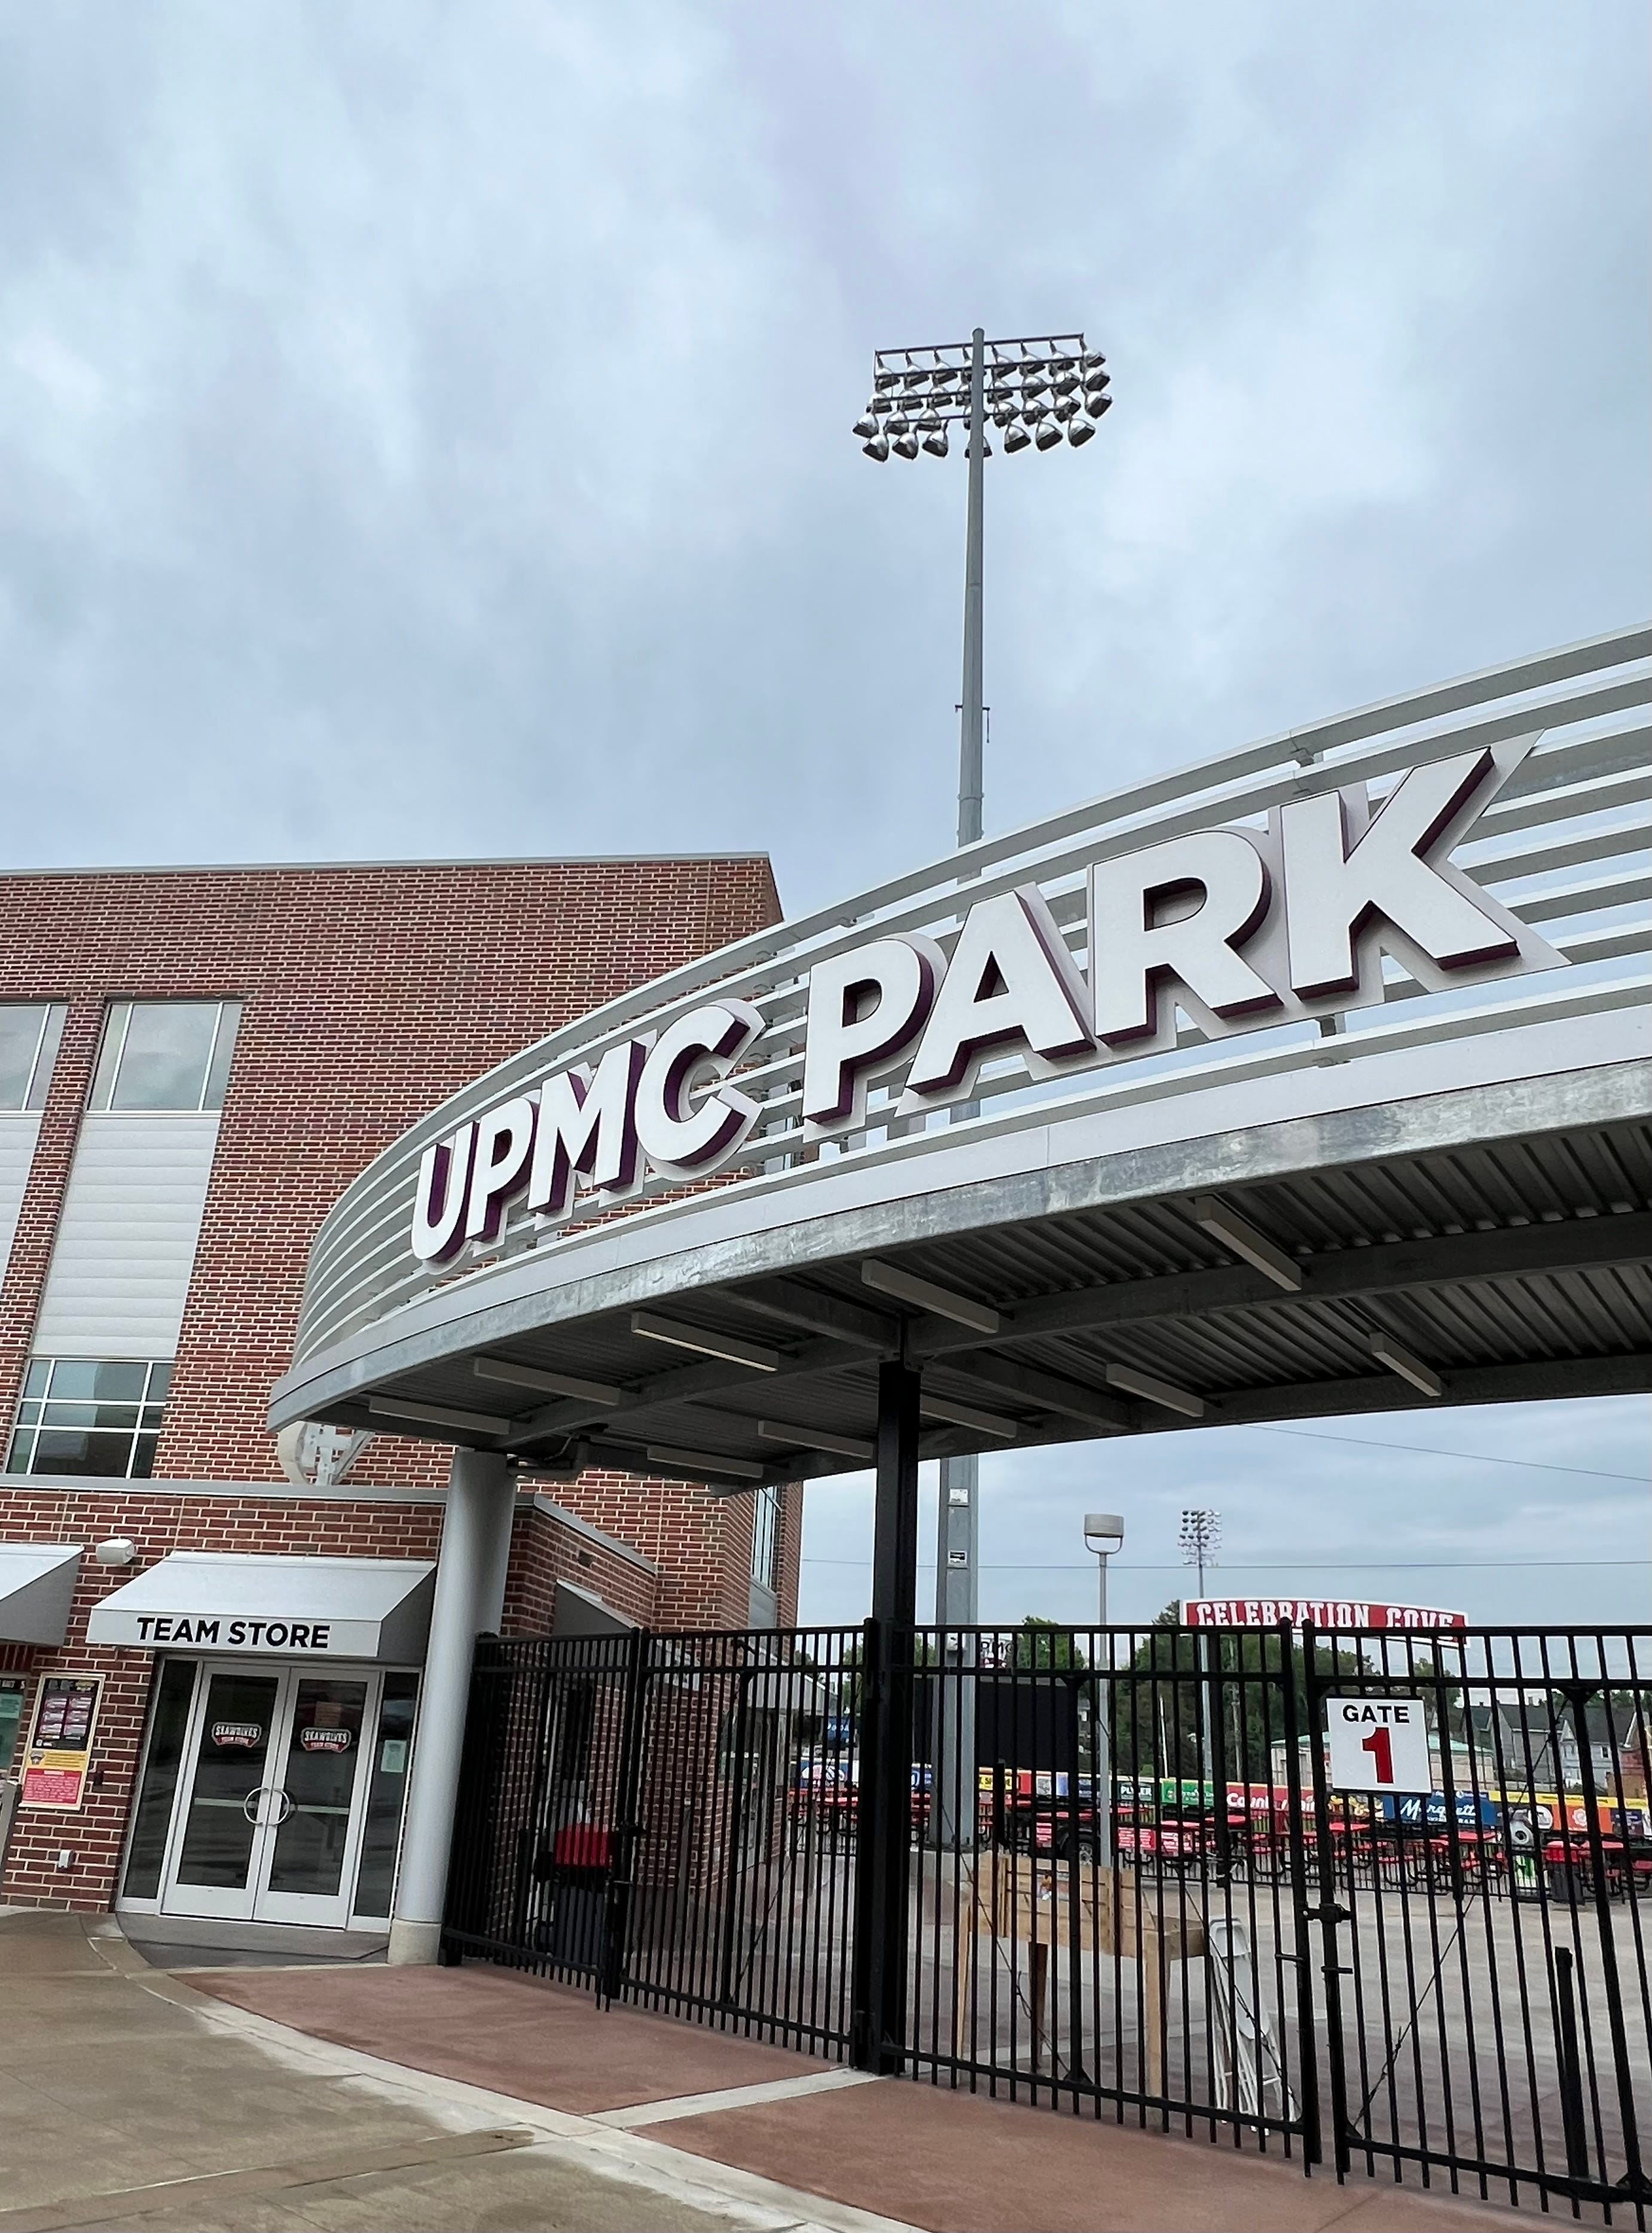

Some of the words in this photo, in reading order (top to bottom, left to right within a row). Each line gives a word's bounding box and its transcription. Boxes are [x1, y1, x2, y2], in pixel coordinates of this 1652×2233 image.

[411, 1003, 751, 1263] UPMC
[802, 746, 1521, 1125] PARK
[1196, 1601, 1369, 1627] CELEBRATION
[137, 1617, 220, 1644] TEAM
[228, 1621, 331, 1648] STORE
[1342, 1704, 1410, 1723] GATE
[1362, 1727, 1394, 1783] 1
